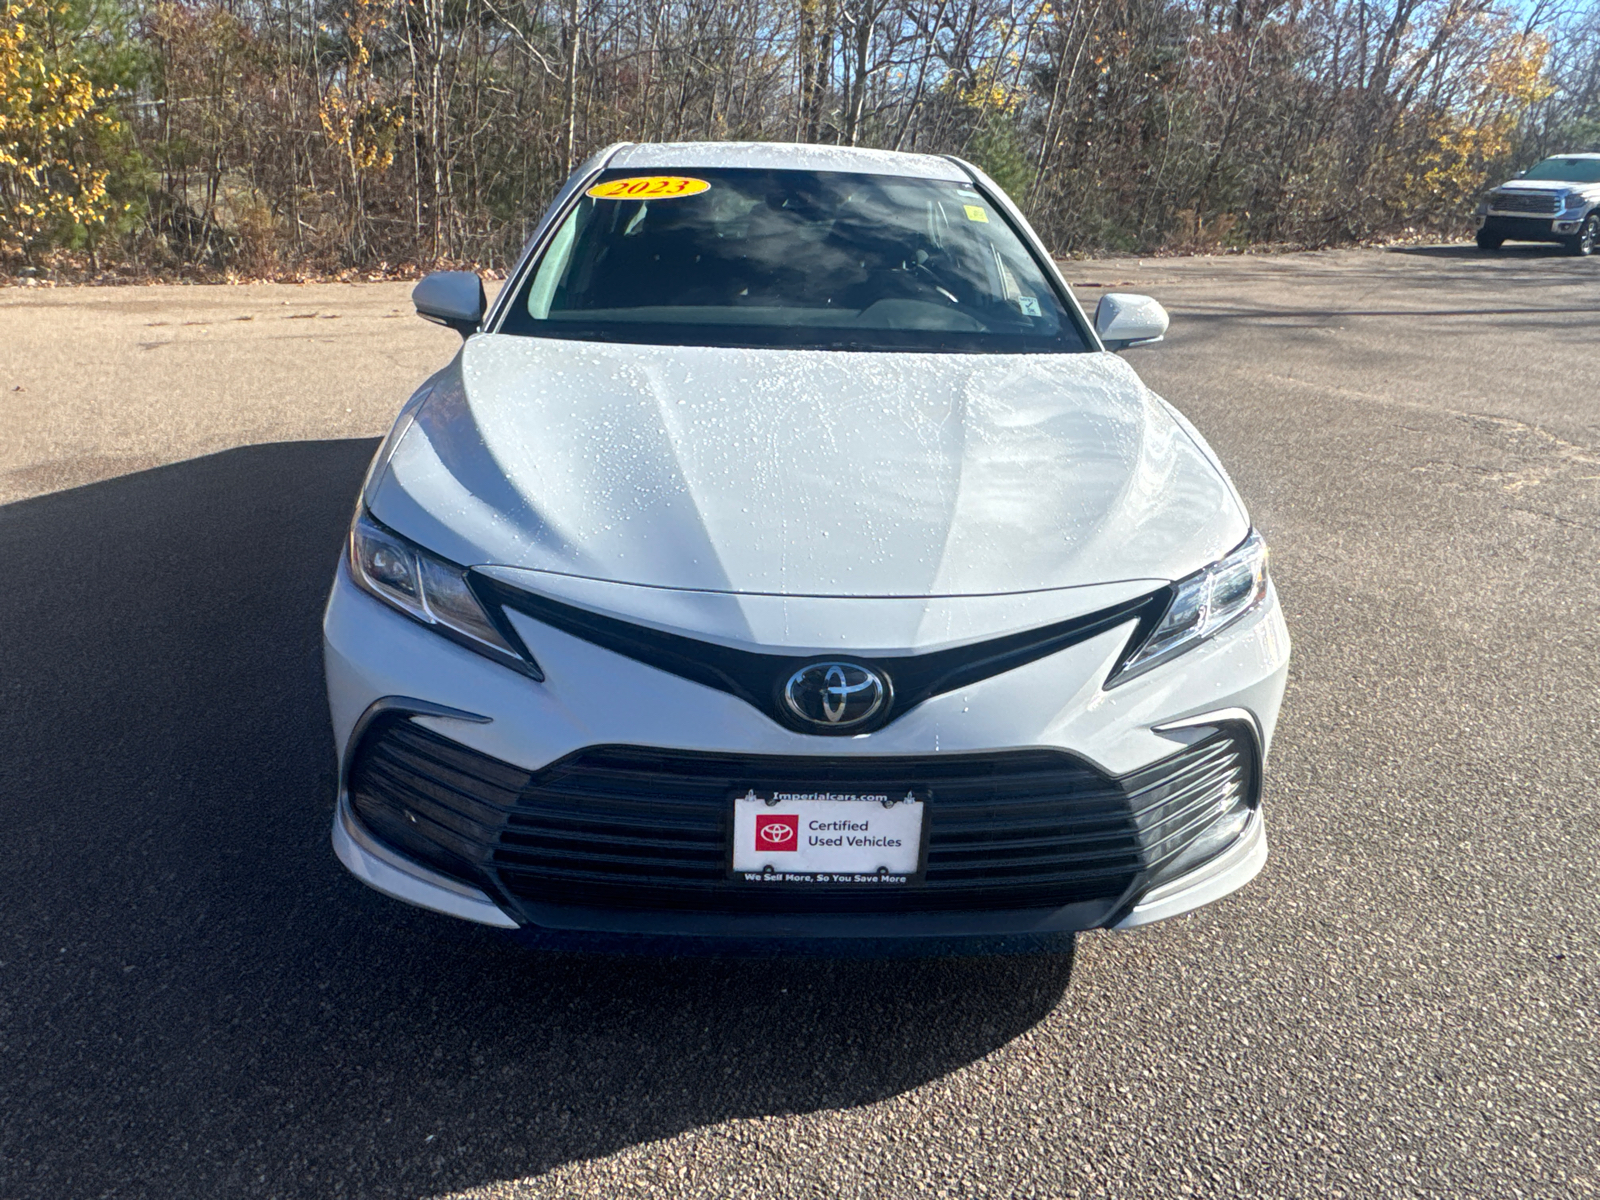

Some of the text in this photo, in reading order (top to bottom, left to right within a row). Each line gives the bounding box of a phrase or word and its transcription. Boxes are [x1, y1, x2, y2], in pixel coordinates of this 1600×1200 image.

[606, 180, 690, 196] 2023
[773, 792, 888, 802] Imperialcars.com
[808, 820, 869, 831] Certified
[808, 836, 902, 847] Used Vehicles
[744, 873, 762, 881] We
[785, 874, 814, 883] More,
